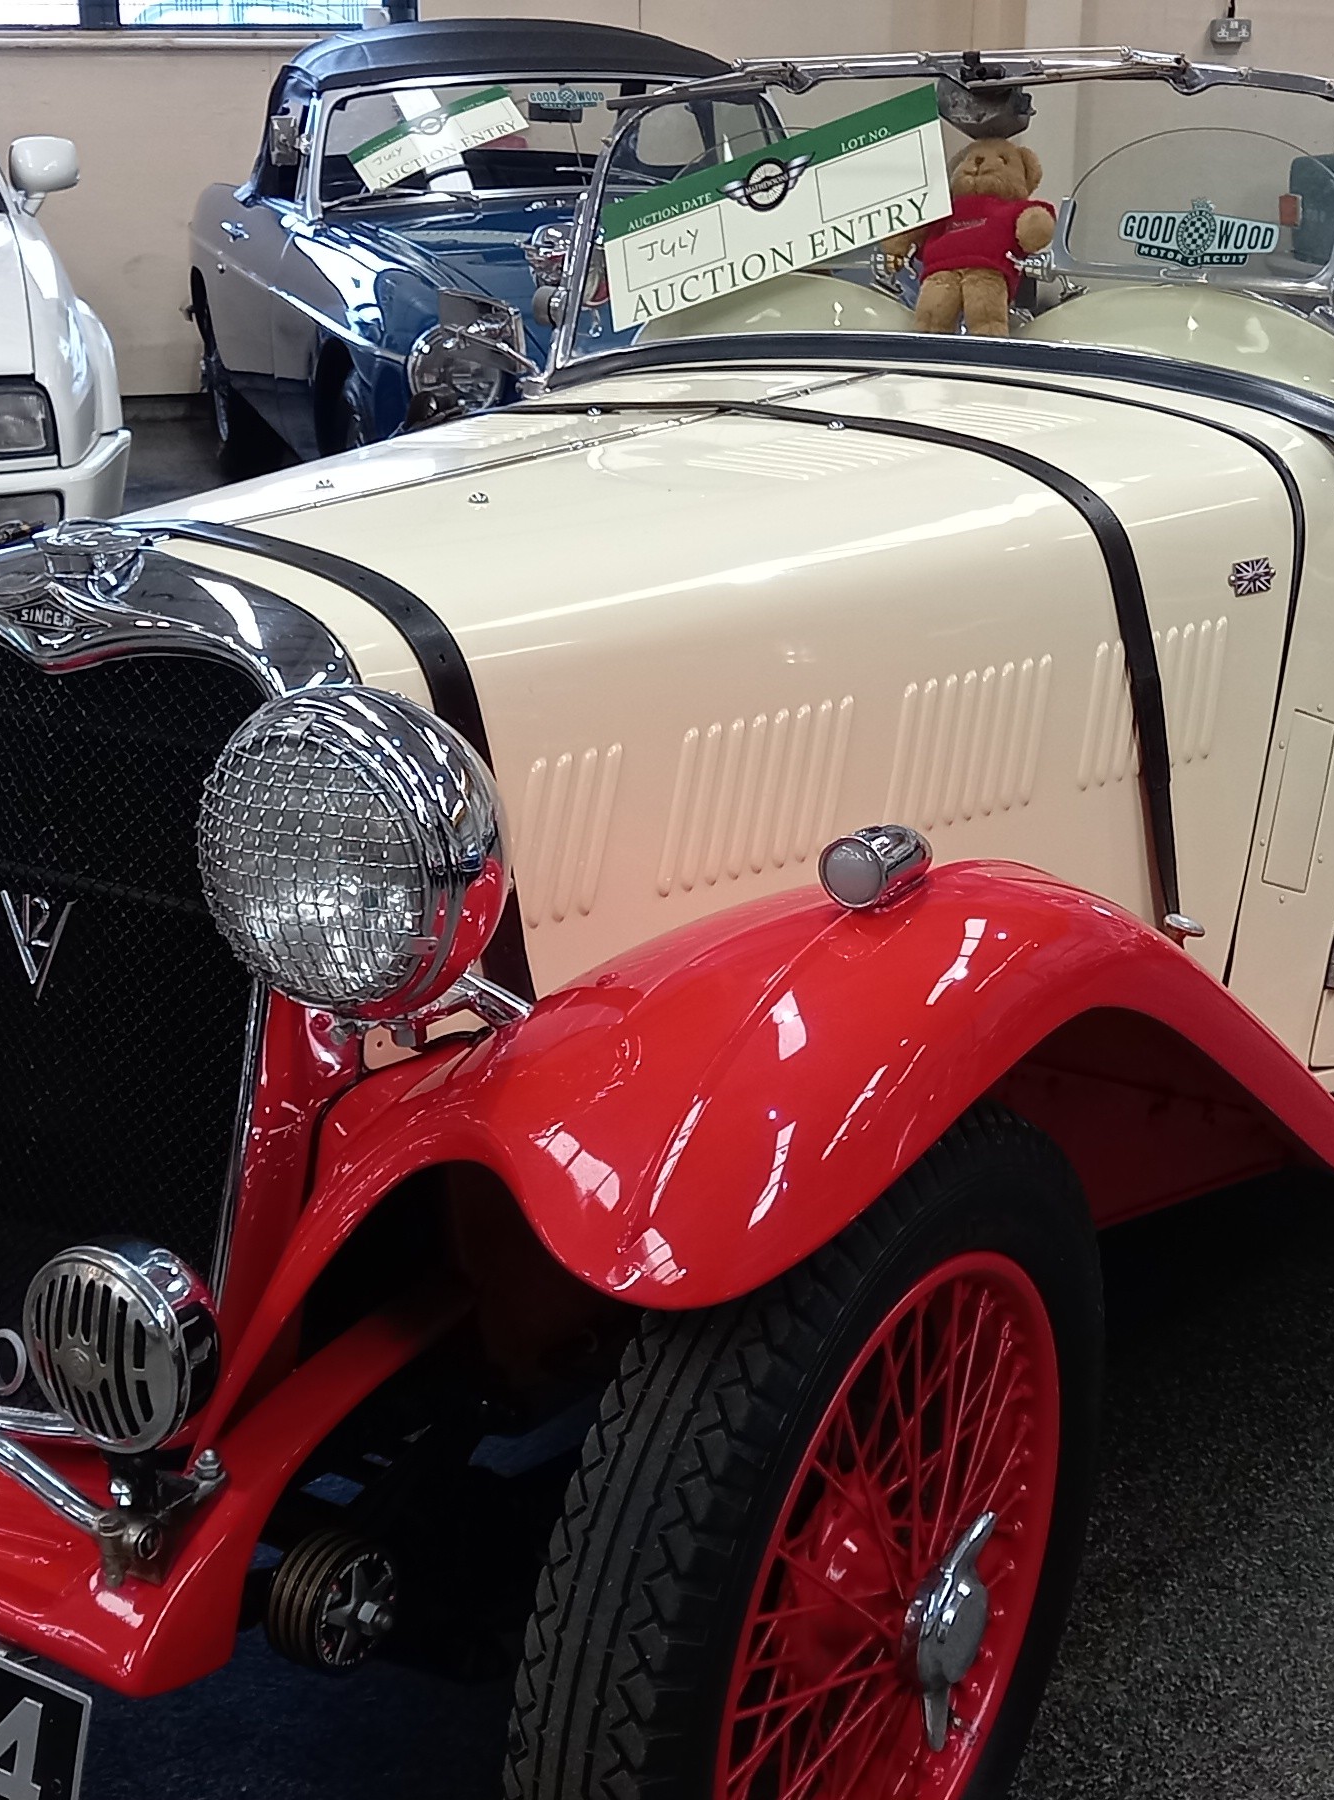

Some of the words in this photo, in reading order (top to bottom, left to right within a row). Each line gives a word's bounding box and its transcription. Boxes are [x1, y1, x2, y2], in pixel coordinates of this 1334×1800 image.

[529, 91, 557, 102] GOOD
[576, 90, 605, 101] WOOD
[377, 142, 458, 189] AUCTION
[460, 119, 517, 148] ENTRY
[841, 133, 866, 153] LOT
[867, 126, 892, 146] NO.
[627, 205, 680, 232] AUCTION
[682, 191, 713, 215] DATE
[637, 227, 700, 263] JULY
[1123, 214, 1177, 244] GOOD
[1217, 218, 1275, 251] WOOD
[632, 240, 795, 322] AUCTION
[809, 191, 930, 258] ENTRY
[1139, 245, 1183, 263] MOTOR
[1187, 253, 1247, 266] CIRCUIT
[20, 607, 74, 627] SINGER
